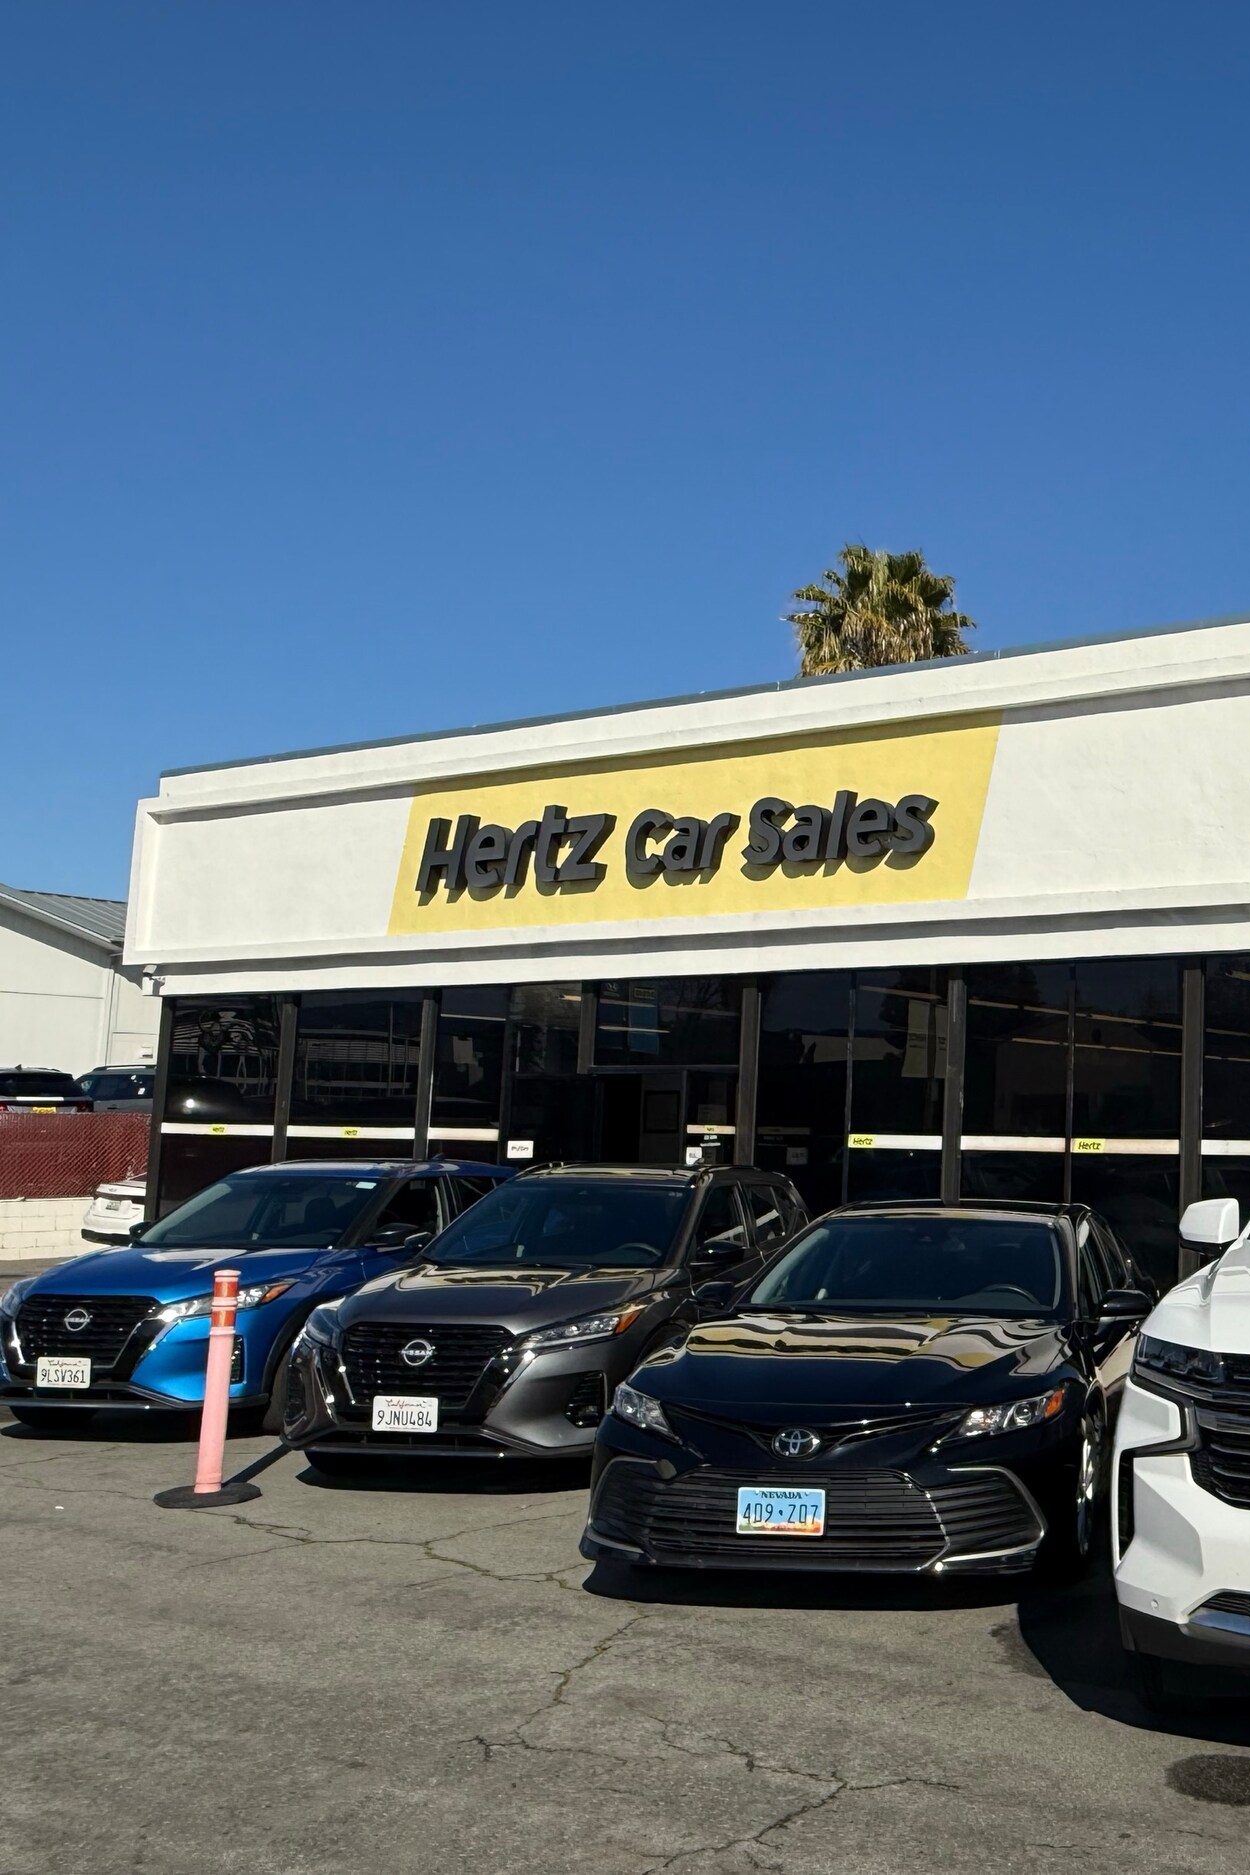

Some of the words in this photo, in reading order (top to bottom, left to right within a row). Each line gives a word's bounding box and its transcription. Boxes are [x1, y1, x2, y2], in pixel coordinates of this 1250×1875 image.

[416, 804, 616, 904] Hertz
[626, 808, 740, 888] Car
[741, 790, 939, 880] Sales
[852, 1137, 873, 1146] Hertz
[1078, 1140, 1101, 1150] Hertz
[40, 1368, 86, 1384] 9LSV361
[376, 1409, 432, 1427] 9JNU484
[760, 1491, 802, 1500] NEVADA
